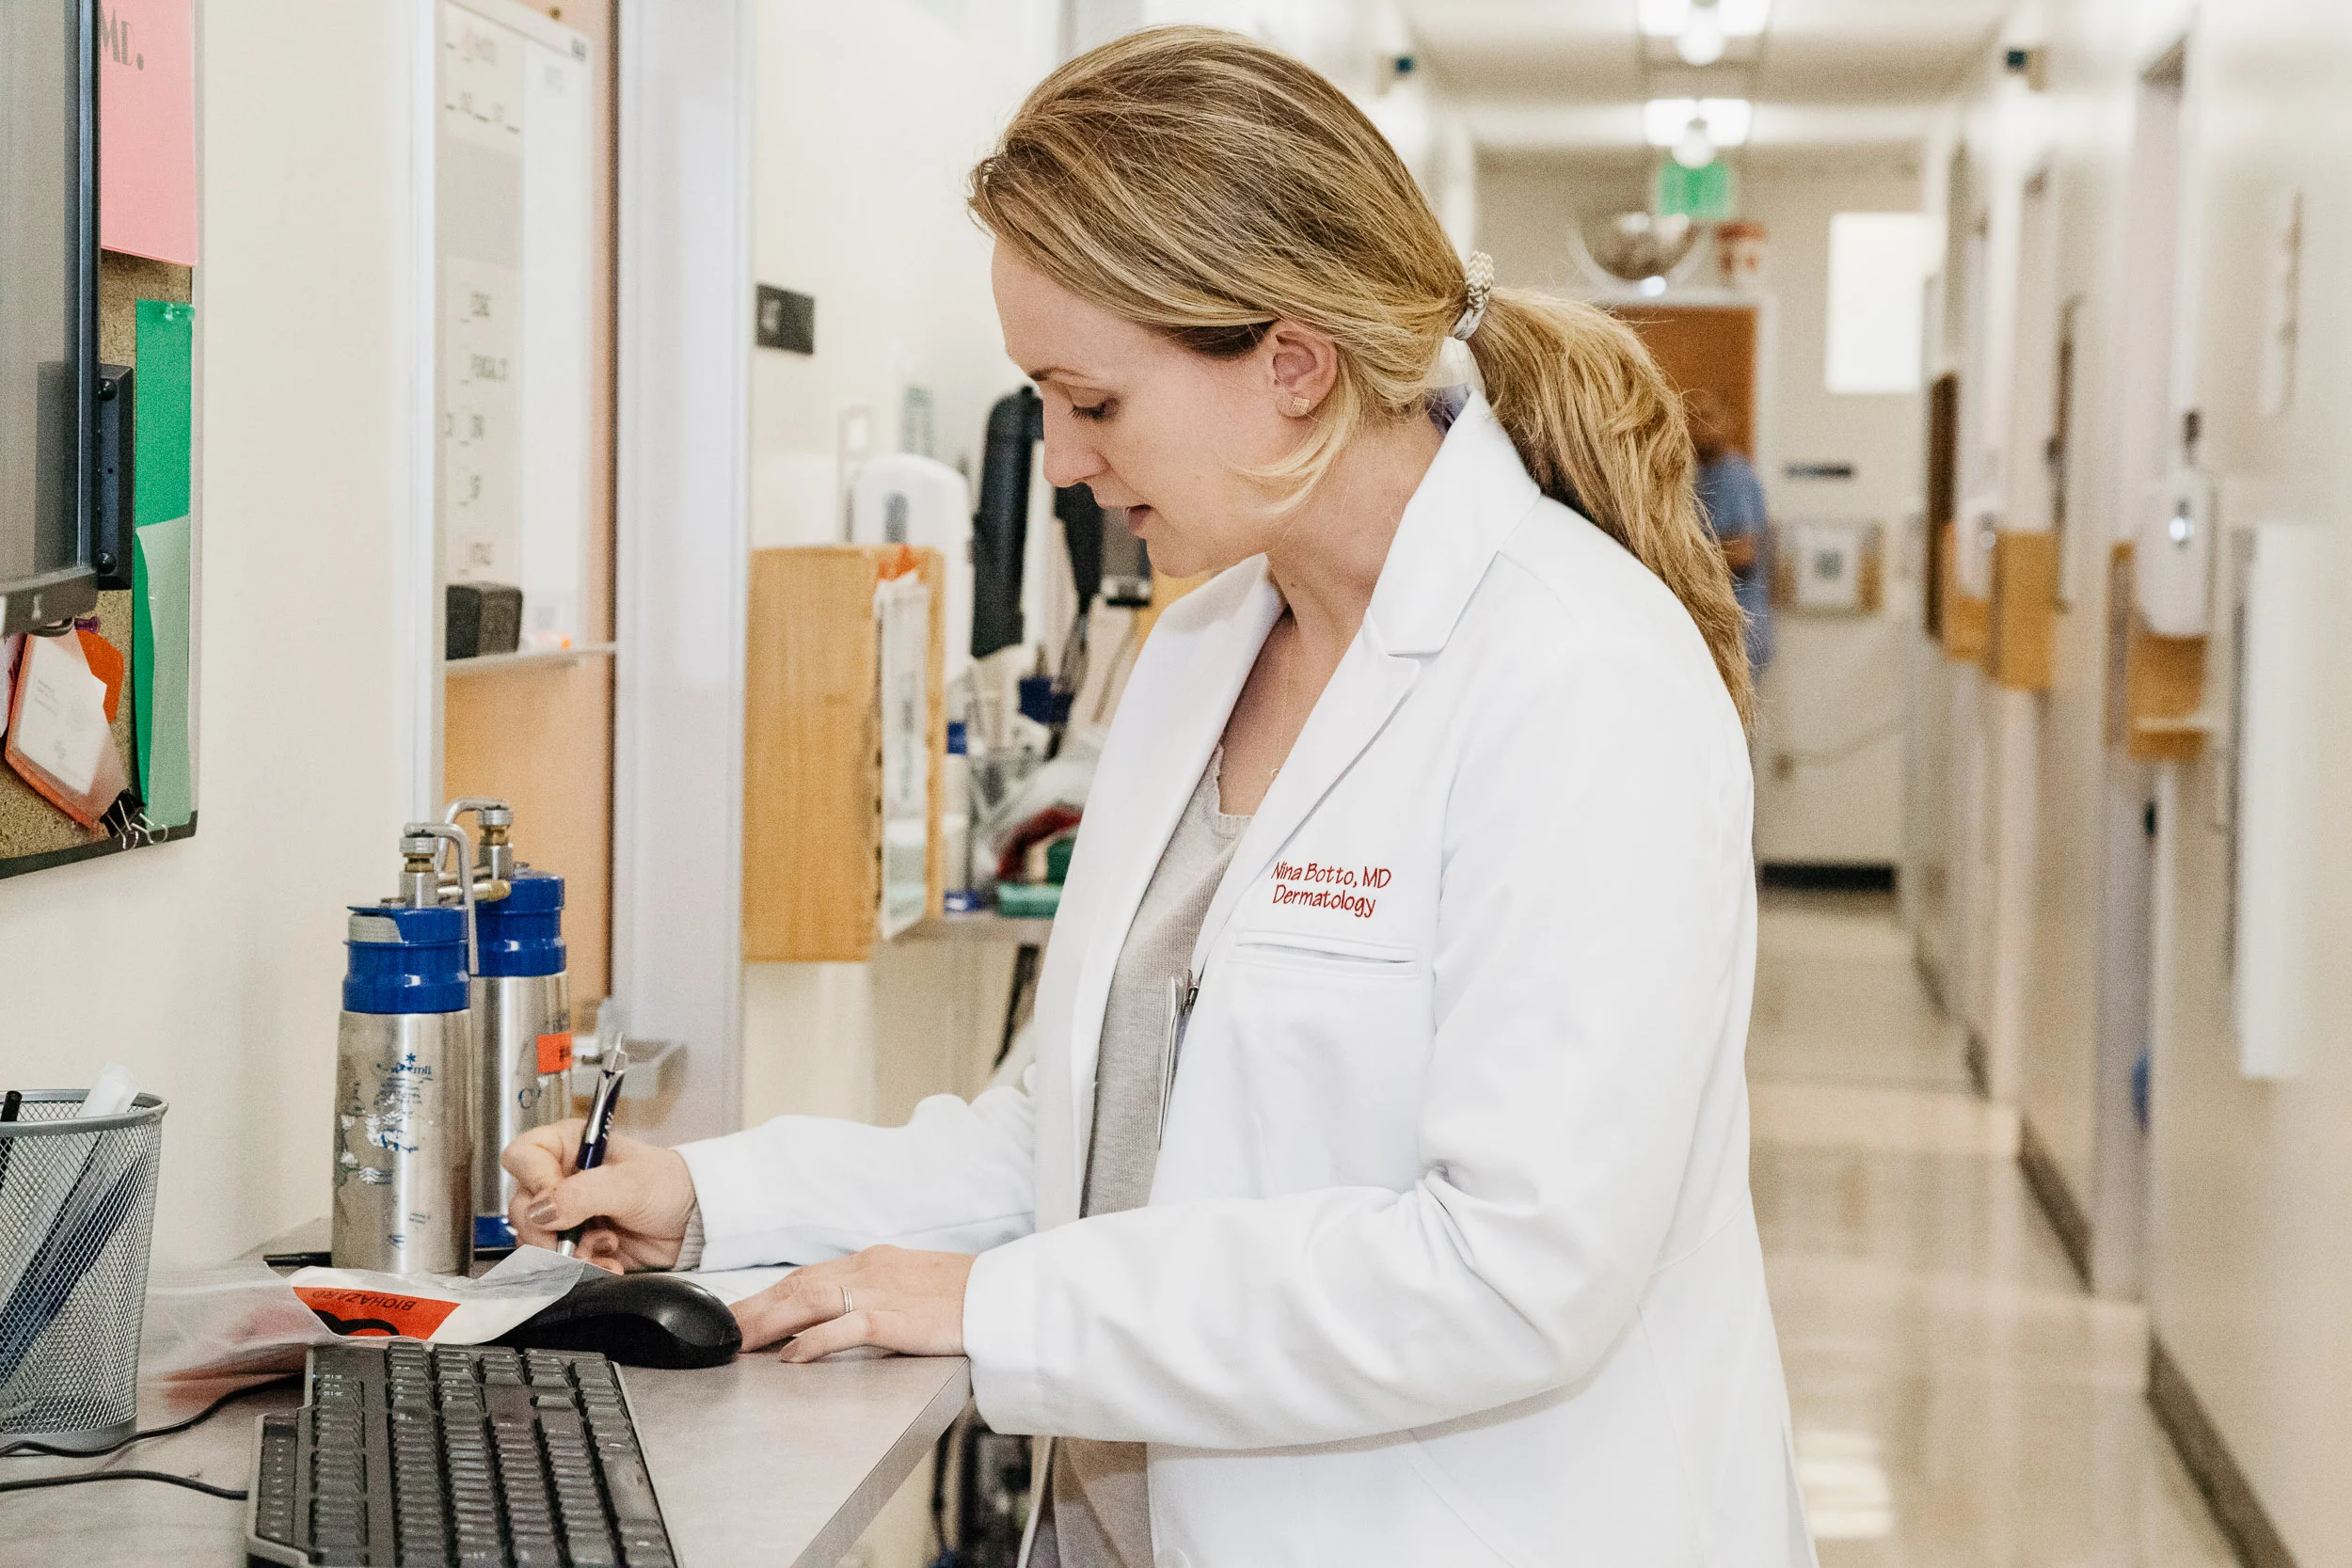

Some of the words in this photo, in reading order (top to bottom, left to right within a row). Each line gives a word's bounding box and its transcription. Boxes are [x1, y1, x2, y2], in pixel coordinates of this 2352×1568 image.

[1271, 862, 1303, 881] Nina
[1304, 863, 1358, 888] Botto,
[1362, 866, 1391, 888] MD
[1272, 884, 1376, 918] Dermatology
[311, 1291, 417, 1311] BIOHAZARD
